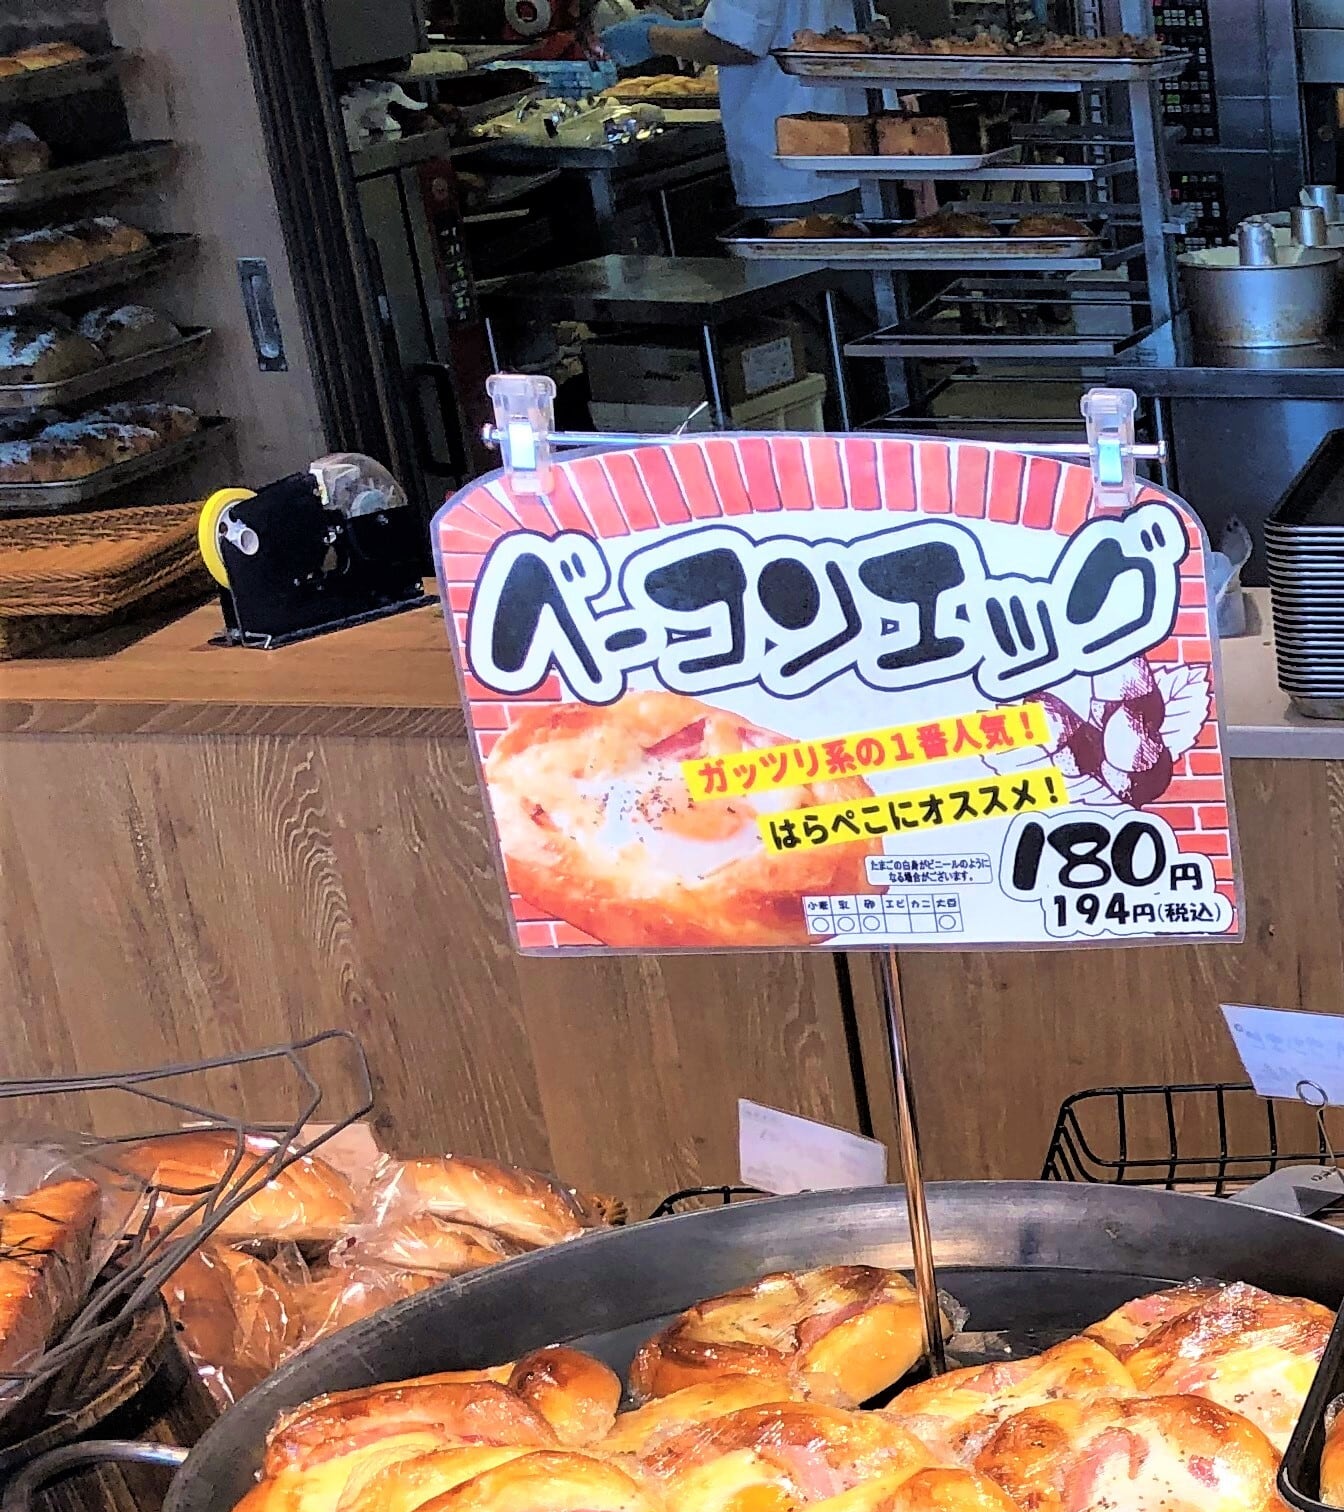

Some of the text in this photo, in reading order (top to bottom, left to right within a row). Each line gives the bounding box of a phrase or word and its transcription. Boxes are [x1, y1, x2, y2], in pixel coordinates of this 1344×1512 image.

[487, 518, 1172, 690] ベーコンエッグ
[1011, 820, 1203, 894] 180円
[1053, 892, 1221, 926] 194円(税込)
